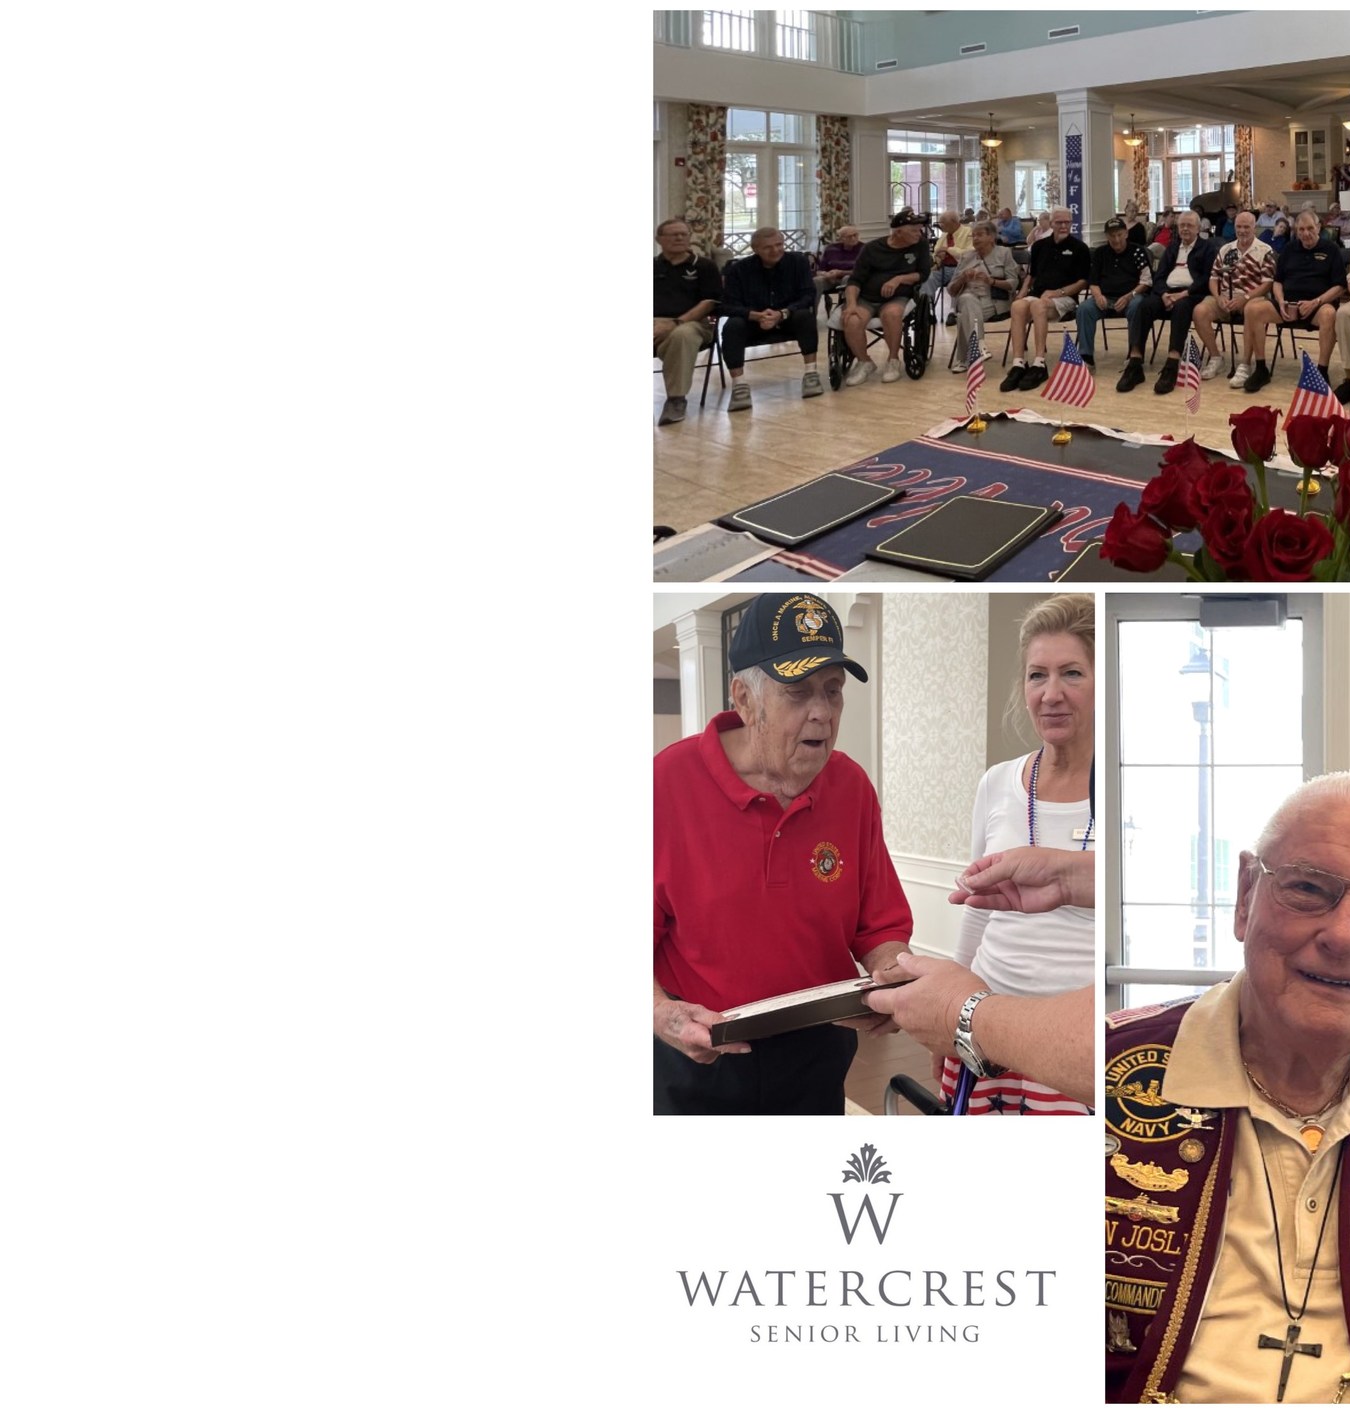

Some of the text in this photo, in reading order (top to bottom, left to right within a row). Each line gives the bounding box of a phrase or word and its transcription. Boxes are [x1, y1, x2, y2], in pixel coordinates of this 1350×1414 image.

[1106, 1051, 1157, 1082] UNITED
[1120, 1117, 1169, 1137] NAVY
[1121, 1225, 1188, 1255] JOSL
